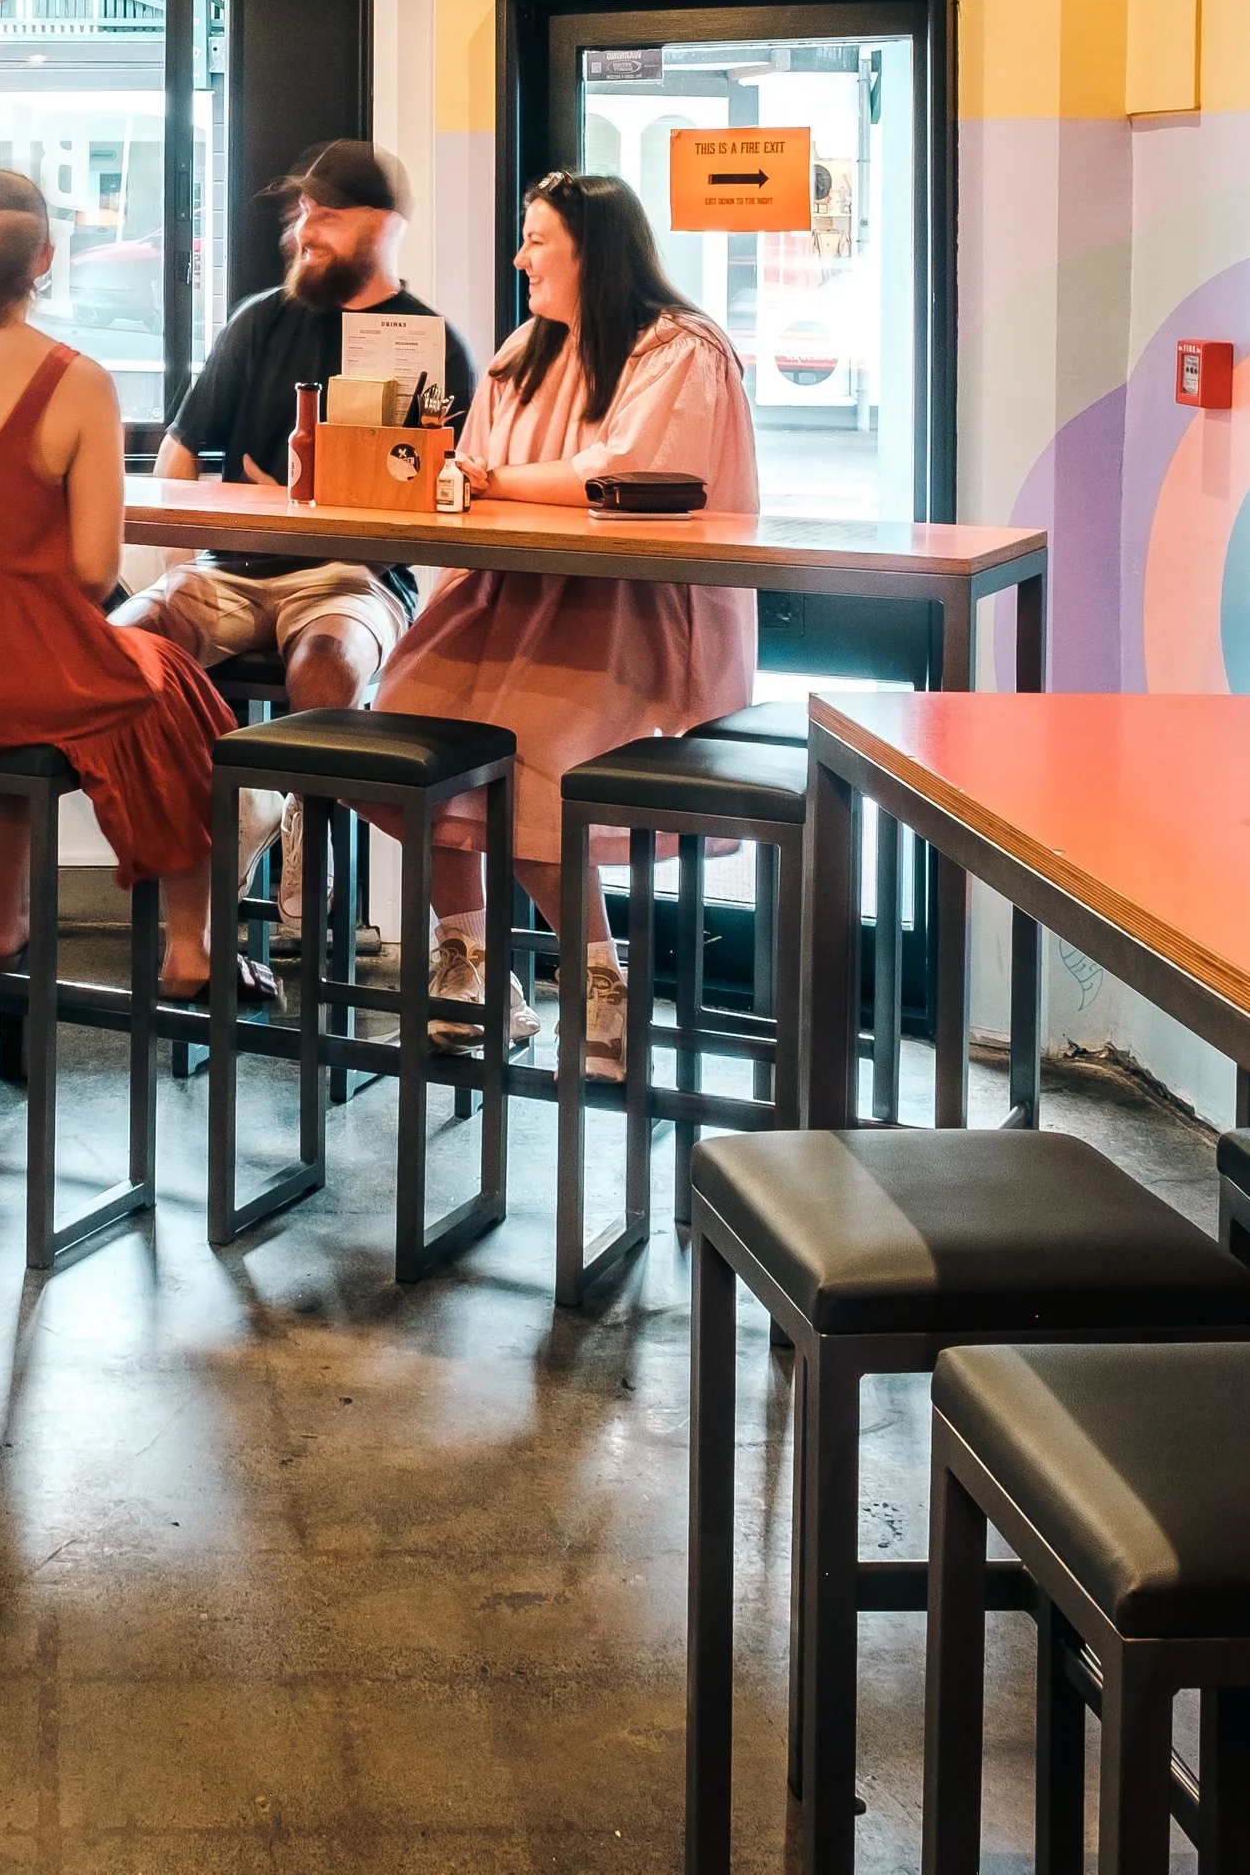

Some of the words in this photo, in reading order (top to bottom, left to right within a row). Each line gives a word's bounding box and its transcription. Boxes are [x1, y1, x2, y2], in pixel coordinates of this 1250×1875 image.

[695, 142, 716, 155] THIS
[718, 142, 727, 154] IS
[730, 142, 737, 154] A
[740, 141, 760, 154] FIRE
[763, 141, 785, 154] EXIT
[736, 197, 743, 205] TO
